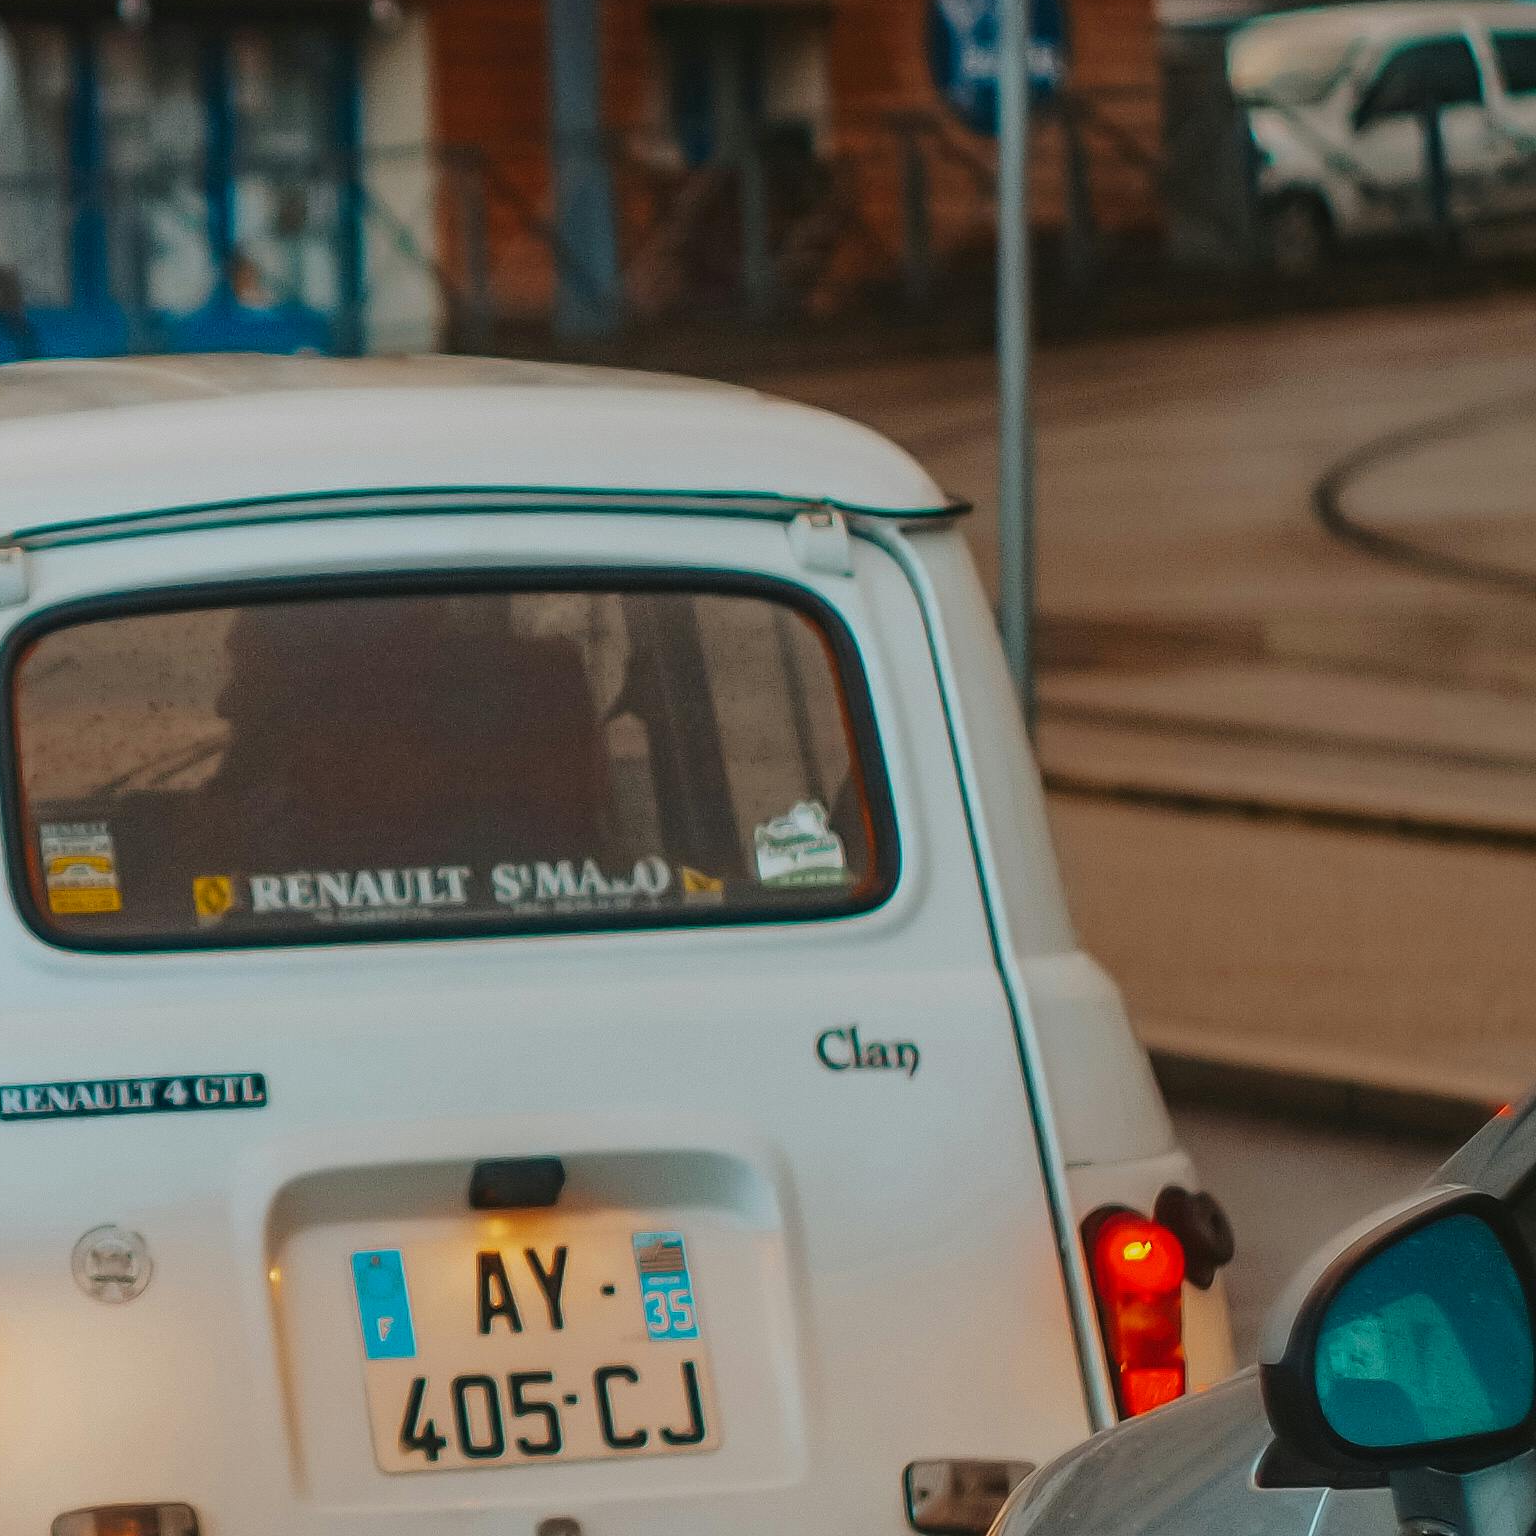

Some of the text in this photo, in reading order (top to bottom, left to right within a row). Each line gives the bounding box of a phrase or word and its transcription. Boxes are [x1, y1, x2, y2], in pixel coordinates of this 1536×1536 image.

[249, 864, 472, 912] RENAULT
[816, 1025, 919, 1077] Clan
[1, 1075, 264, 1114] RENAULT 4 GTL
[378, 1317, 394, 1341] F
[644, 1289, 695, 1333] 35
